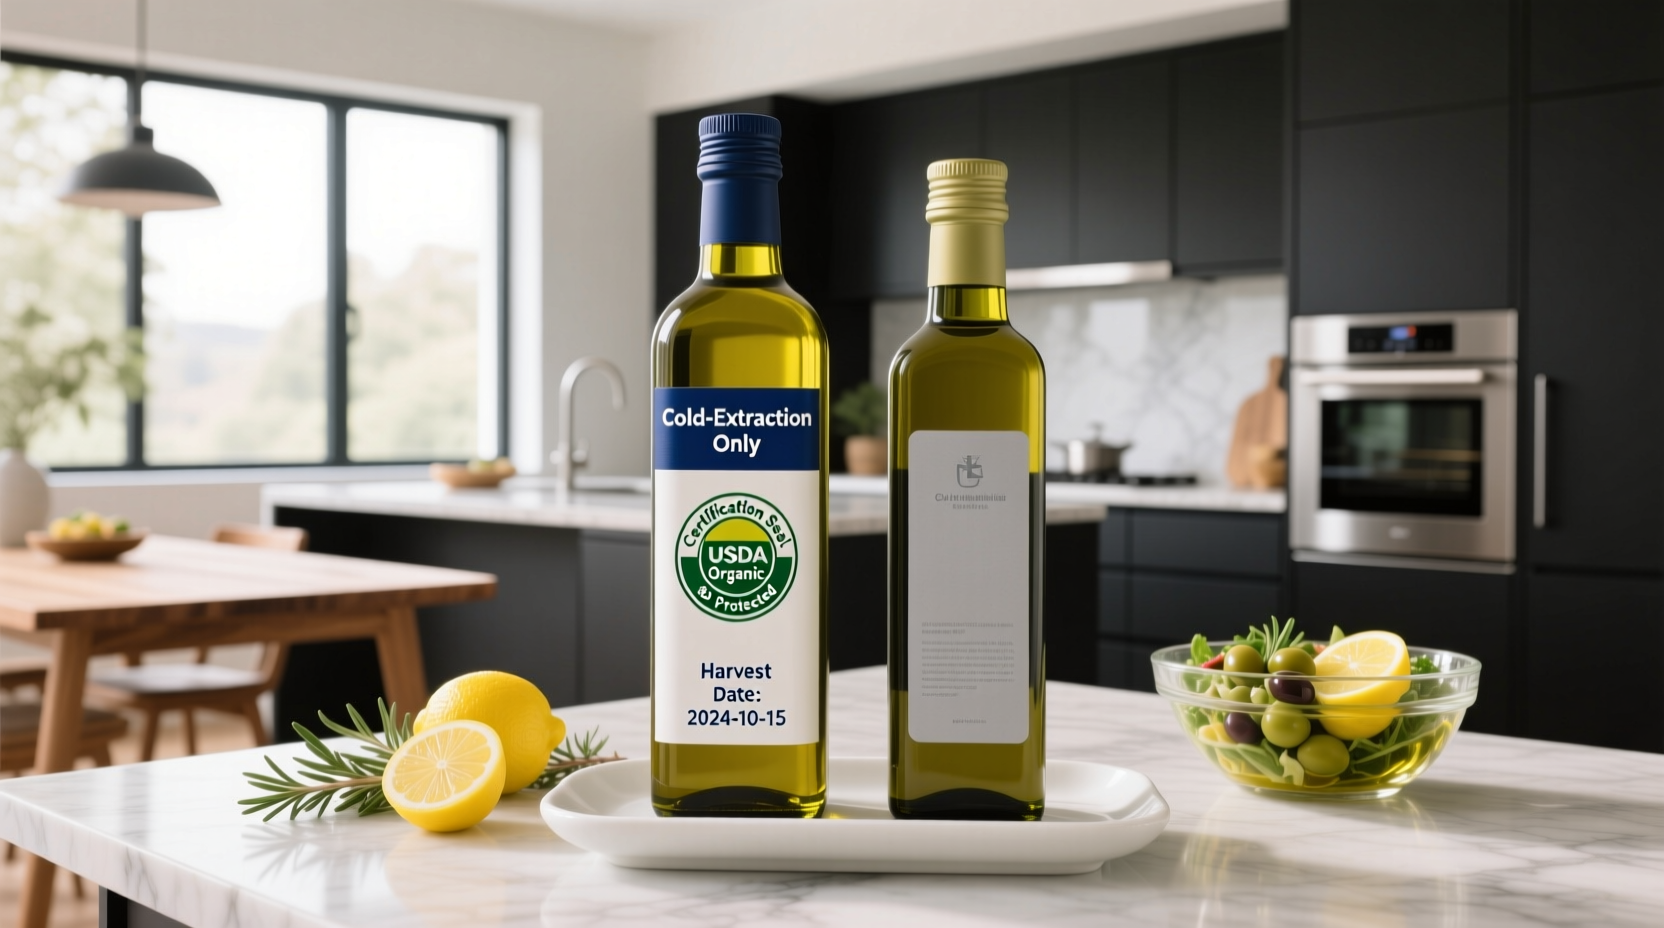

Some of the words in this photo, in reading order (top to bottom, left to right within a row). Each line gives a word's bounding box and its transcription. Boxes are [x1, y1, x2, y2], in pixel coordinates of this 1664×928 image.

[662, 407, 812, 427] Cold-Extraction
[712, 433, 762, 458] Only
[708, 546, 769, 564] USDA
[708, 566, 765, 585] Organic
[701, 662, 772, 679] Harvest
[713, 686, 762, 702] Date:
[687, 709, 786, 726] 2024-10-15
